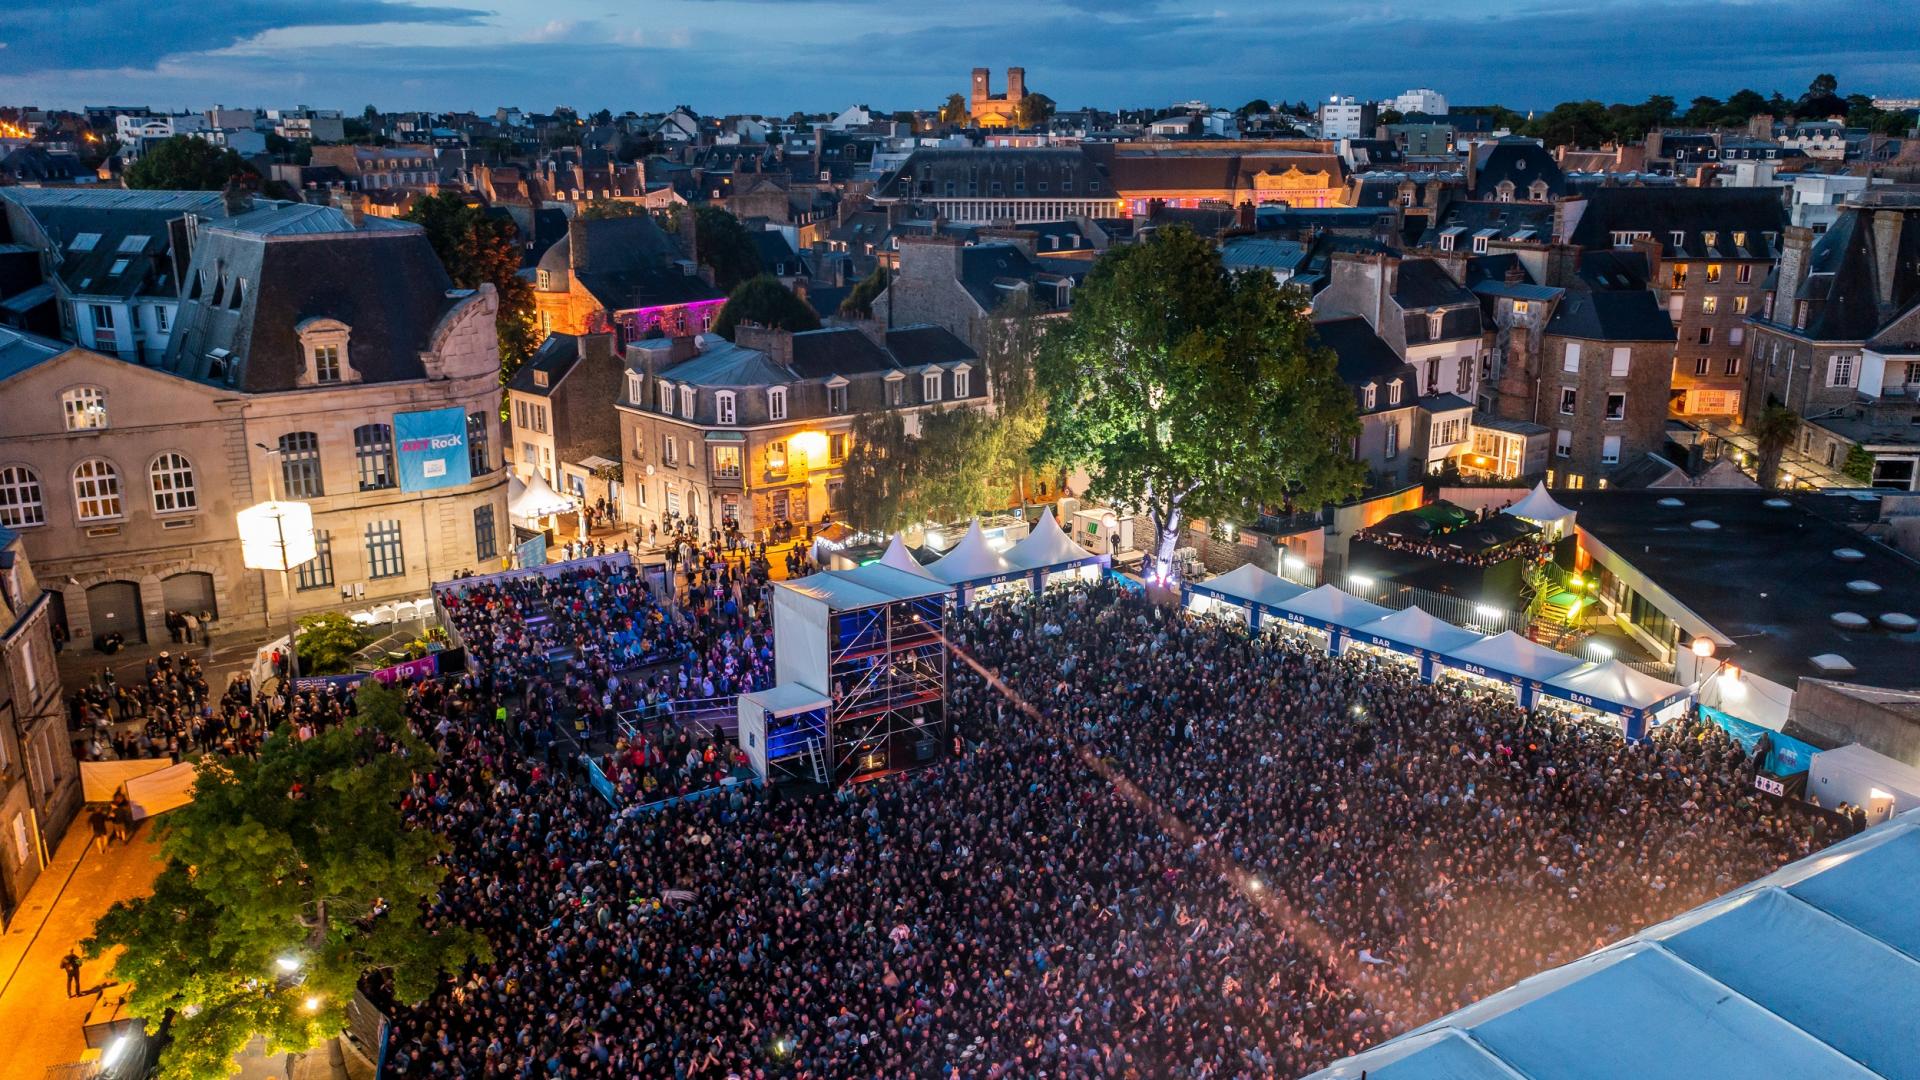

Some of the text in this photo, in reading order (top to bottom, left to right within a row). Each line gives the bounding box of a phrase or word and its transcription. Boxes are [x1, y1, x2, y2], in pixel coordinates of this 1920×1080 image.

[401, 440, 430, 452] ART
[1067, 560, 1082, 569] BAR
[991, 575, 1007, 584] BAR
[1210, 590, 1226, 601] BAR
[1288, 612, 1305, 624] BAR
[1372, 636, 1391, 648] BAR
[1465, 663, 1486, 676] BAR
[1570, 692, 1593, 706] BAR
